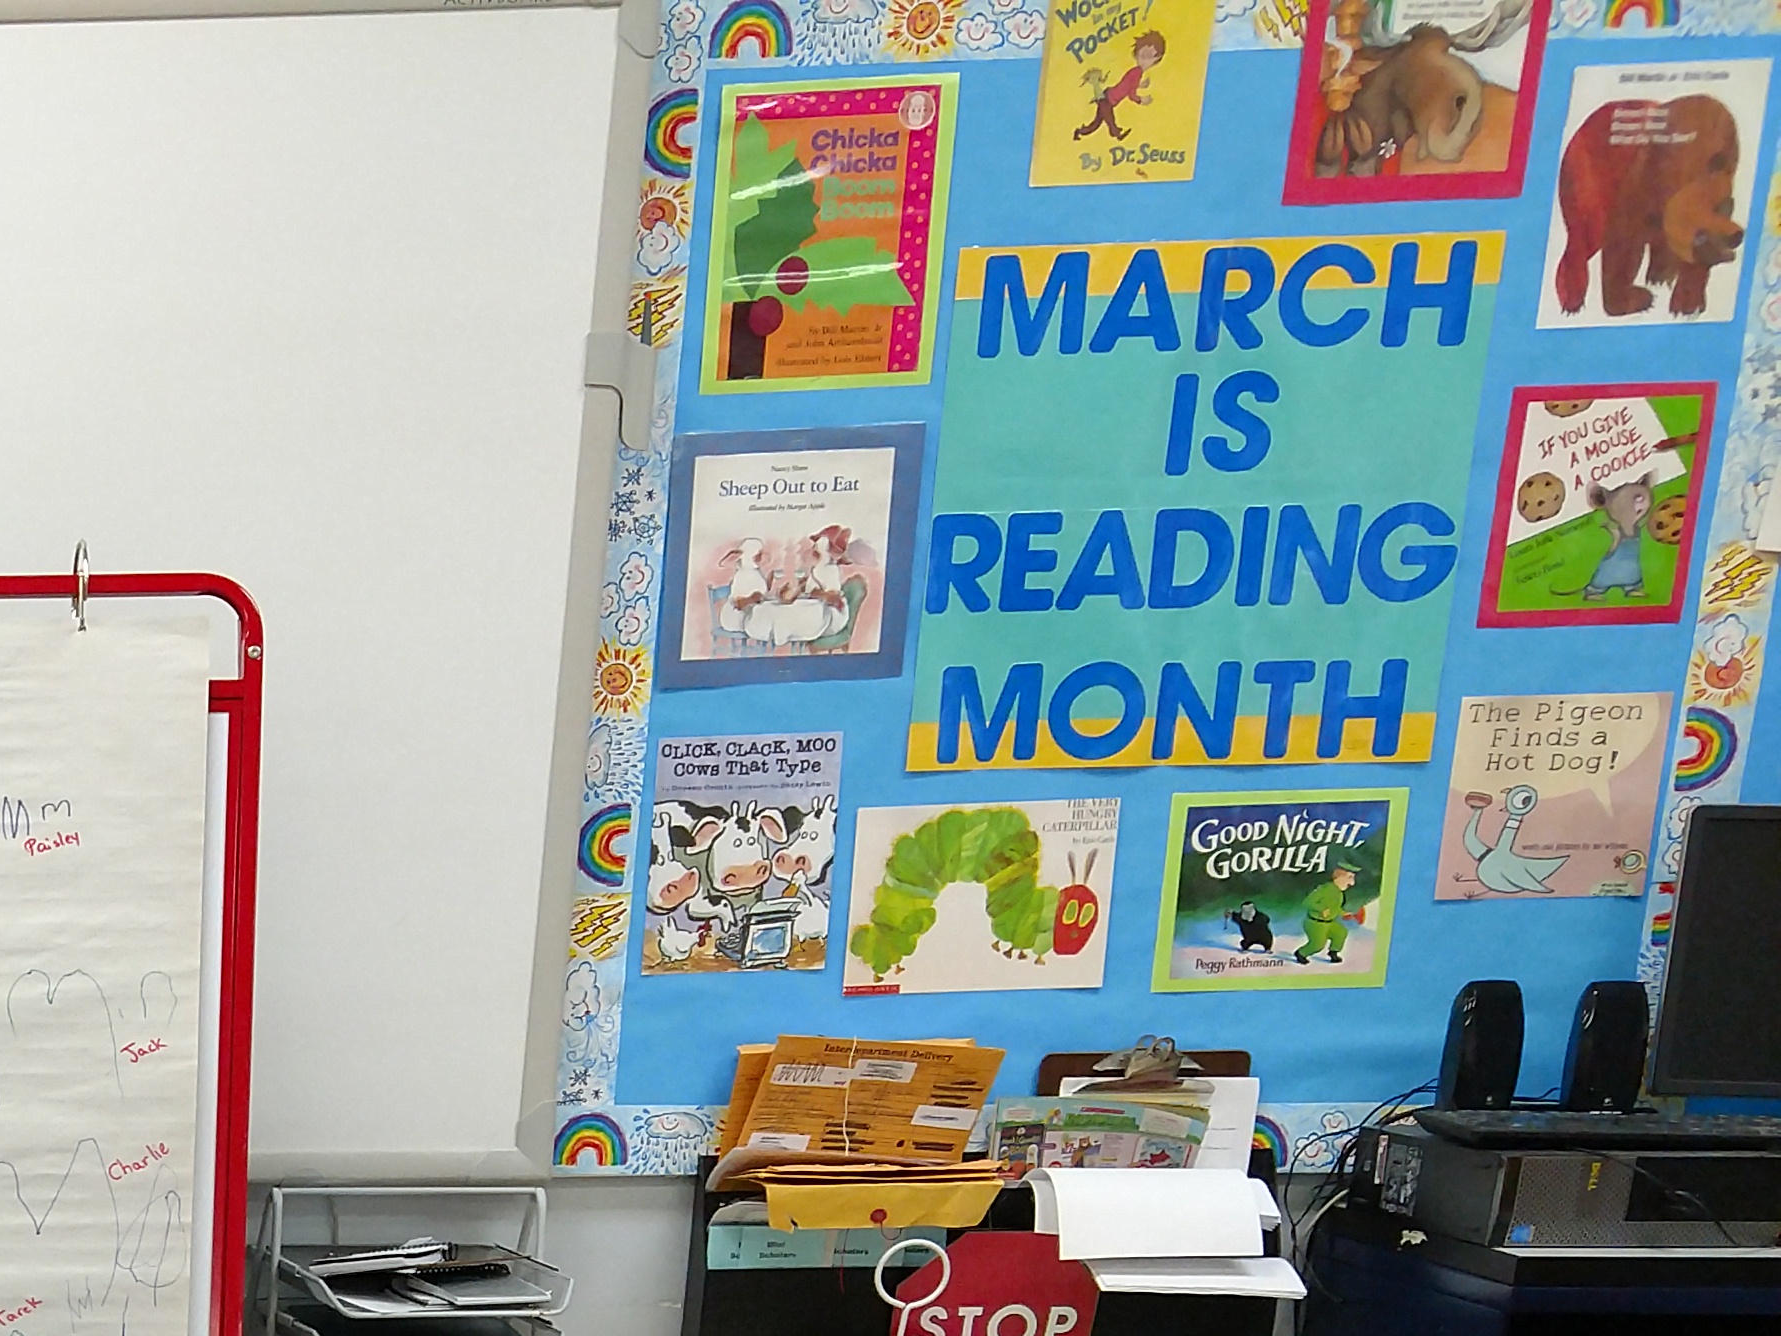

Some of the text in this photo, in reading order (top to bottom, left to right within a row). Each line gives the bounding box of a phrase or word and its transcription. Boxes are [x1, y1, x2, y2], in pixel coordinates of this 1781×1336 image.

[811, 127, 900, 152] Chicka
[810, 151, 898, 175] Chicka
[1079, 143, 1186, 172] By Dr. Seuss
[823, 177, 896, 199] Boom
[820, 199, 895, 222] Boom
[976, 239, 1478, 359] MARCH
[1164, 369, 1281, 476] IS
[1538, 406, 1634, 460] IF YOU GIVE
[1570, 426, 1643, 469] A MOUSE
[1574, 442, 1652, 491] A COOKIE
[718, 476, 859, 500] Sheep Out to Eat
[925, 501, 1459, 615] READING
[936, 658, 1410, 764] MONTH
[1469, 700, 1643, 726] The Pigeon
[661, 737, 836, 760] CLICK, CLACK, MOO
[1490, 727, 1608, 748] Finds a
[673, 757, 821, 778] Cows That Type
[1485, 750, 1619, 774] Hot Dog!
[1067, 797, 1119, 808] THE VERY
[1072, 809, 1117, 820] HUNGRY
[1042, 820, 1118, 832] CATERPILLAR
[1191, 818, 1270, 854] GOOD
[23, 830, 81, 857] Paisley
[1206, 844, 1328, 880] GORILLA
[1195, 958, 1226, 974] Peggy
[119, 1037, 168, 1064] Jack
[912, 1049, 954, 1063] Delivery
[107, 1139, 171, 1183] Charlie
